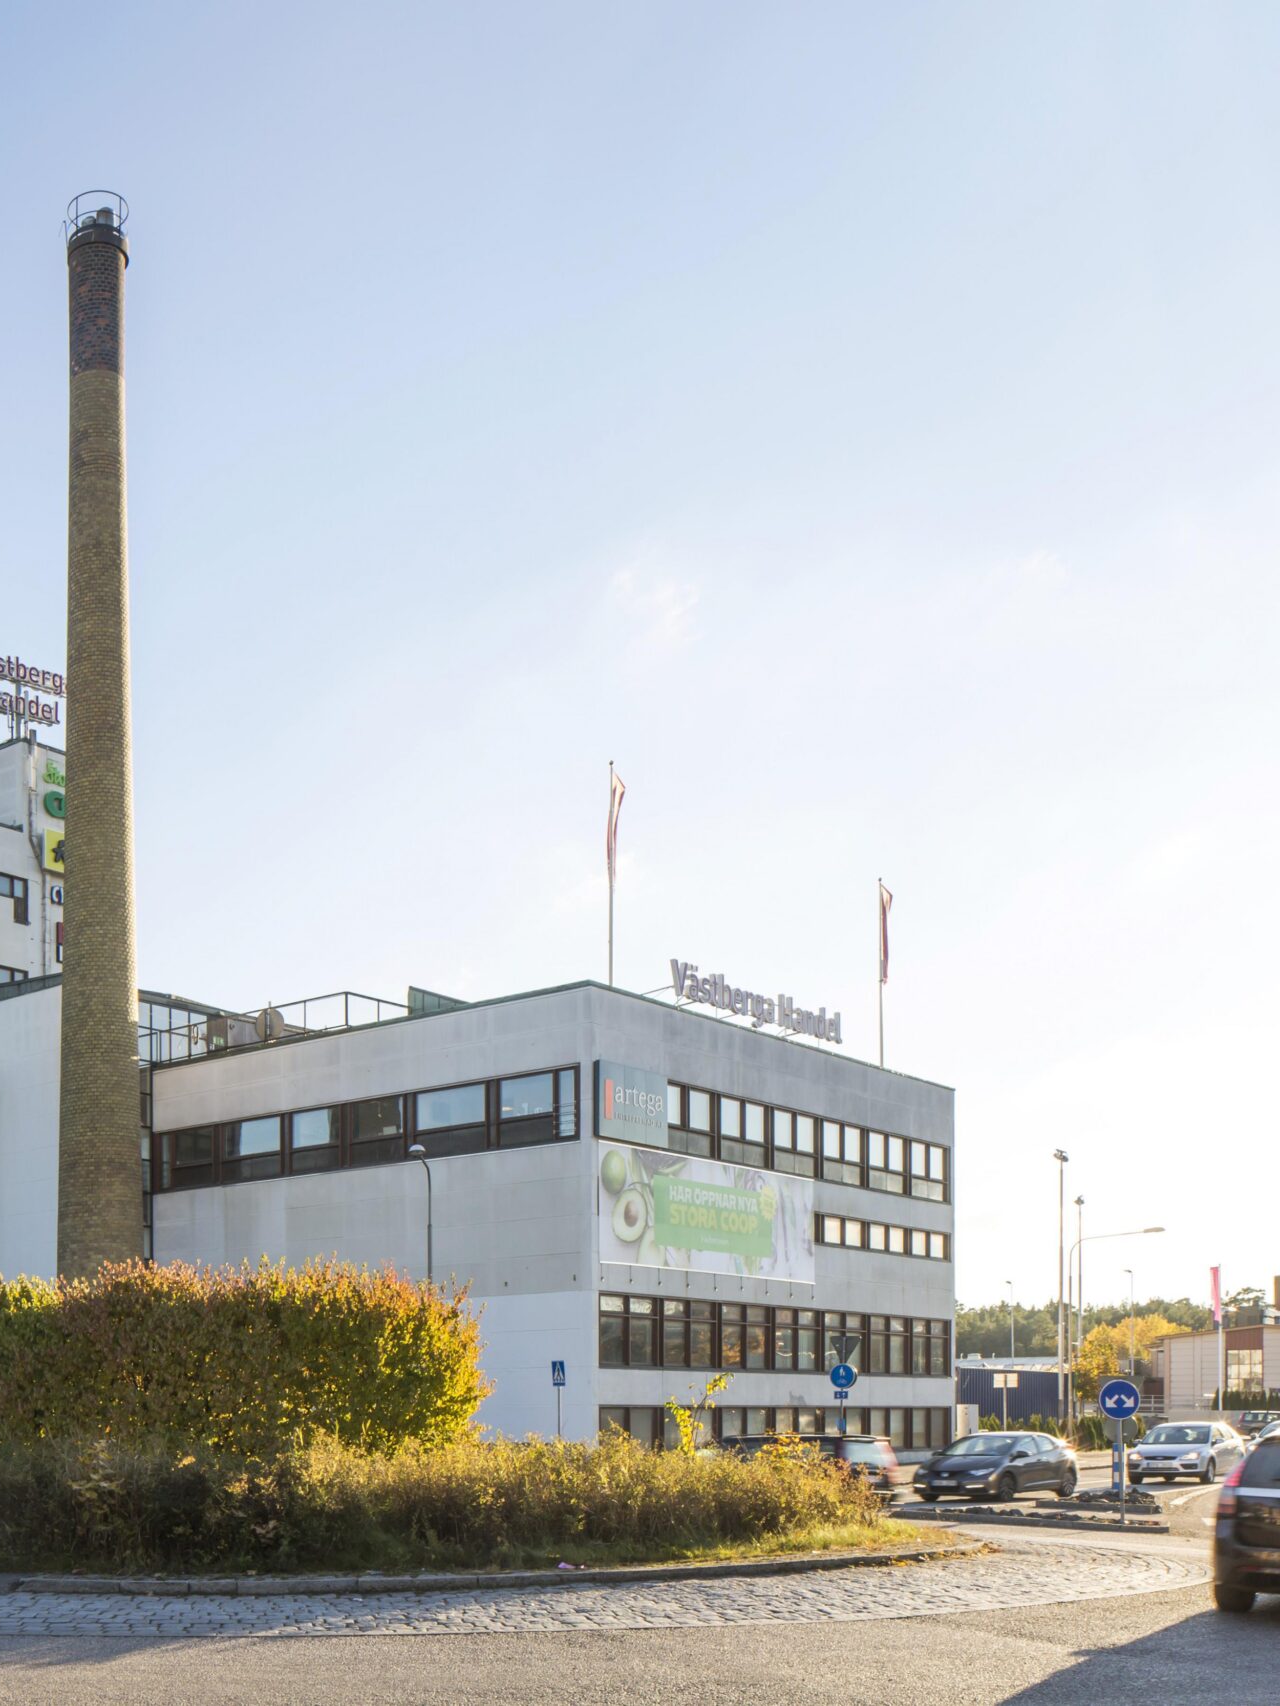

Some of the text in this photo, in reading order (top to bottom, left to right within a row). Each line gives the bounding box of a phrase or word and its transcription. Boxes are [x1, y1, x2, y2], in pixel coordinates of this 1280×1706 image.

[670, 958, 842, 1044] Västberga Handel
[615, 1086, 664, 1117] artega
[694, 1187, 737, 1210] ÖPPNAR
[738, 1196, 759, 1213] NYA
[669, 1203, 718, 1232] STORA
